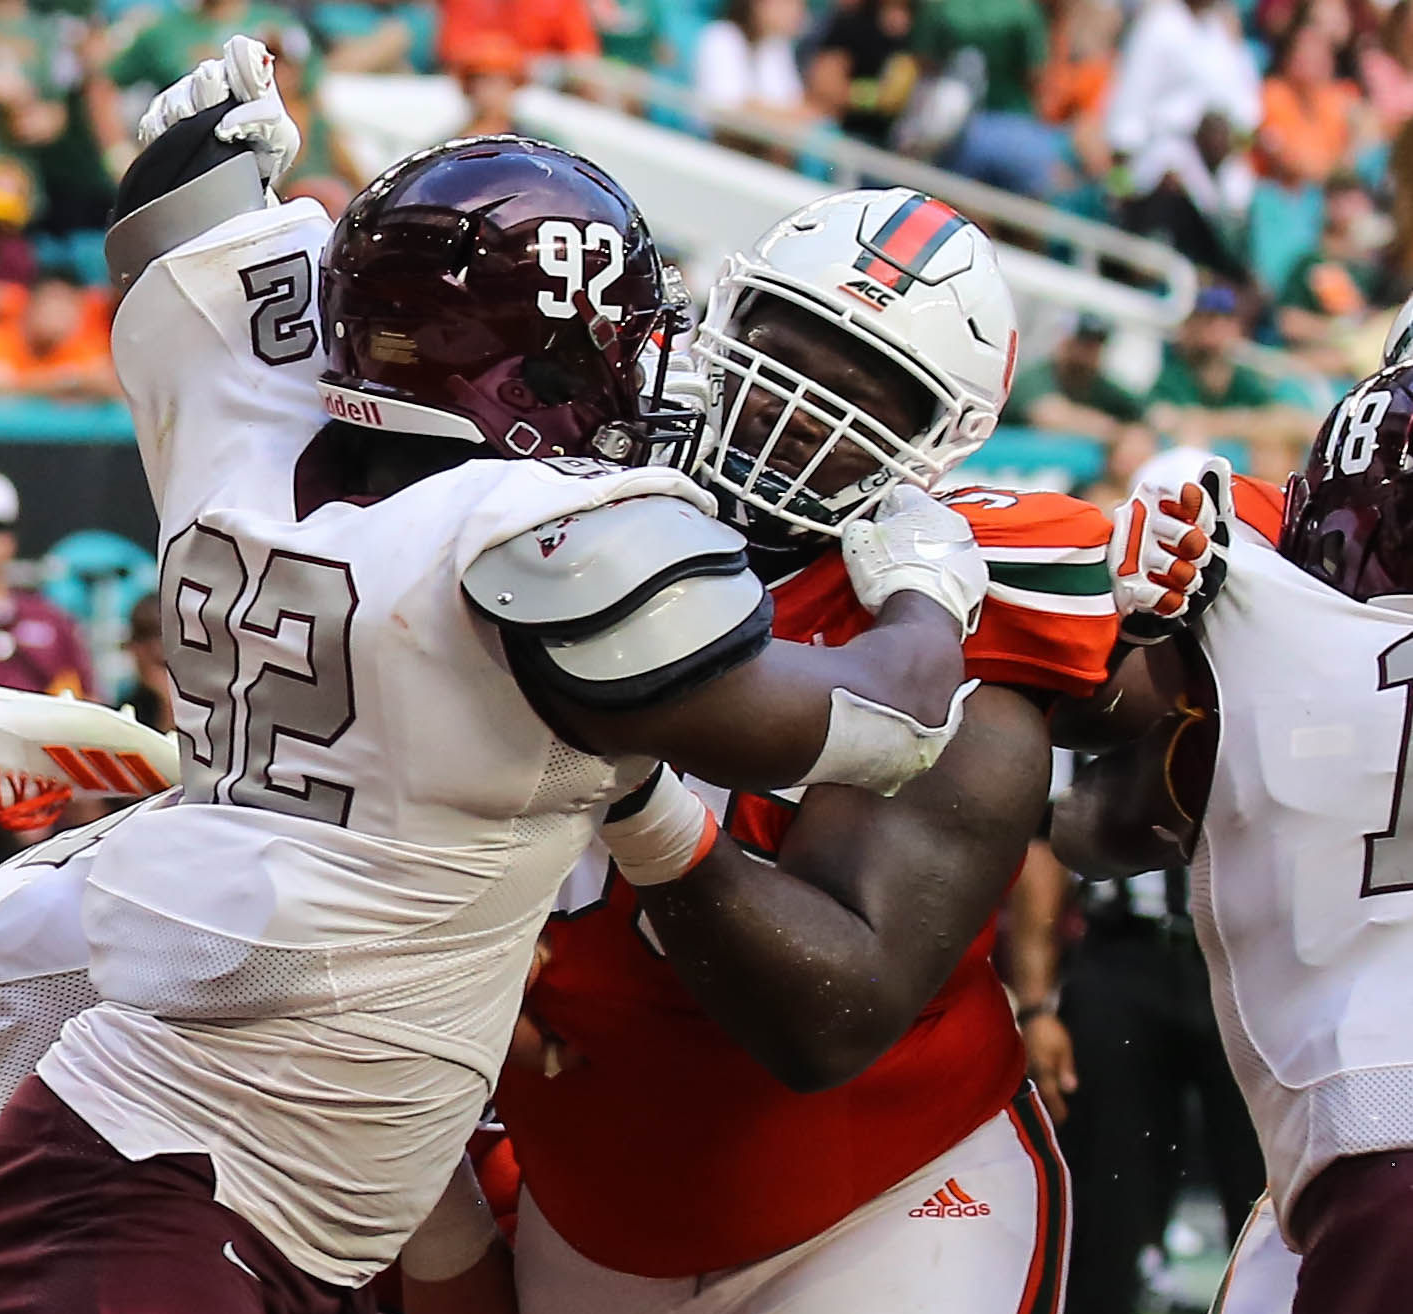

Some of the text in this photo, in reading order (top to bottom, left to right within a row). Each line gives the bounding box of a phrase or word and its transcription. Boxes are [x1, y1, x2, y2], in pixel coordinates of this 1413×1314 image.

[238, 250, 320, 367] 2
[537, 221, 625, 321] 92
[845, 280, 896, 307] ACC
[1323, 390, 1392, 481] 18
[159, 520, 360, 828] 92
[908, 1202, 991, 1219] adidas
